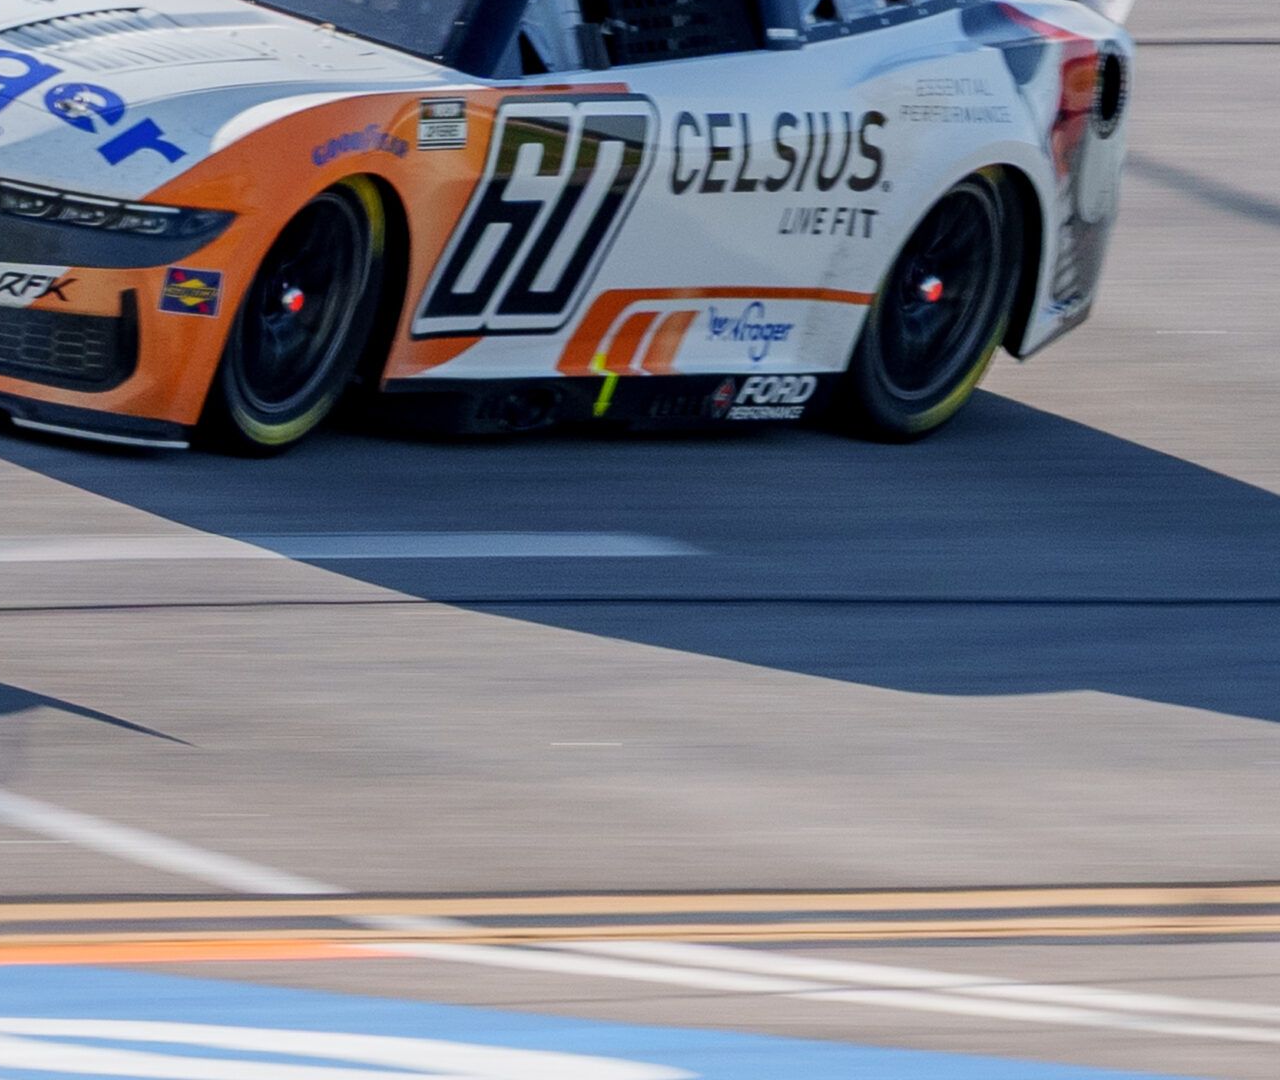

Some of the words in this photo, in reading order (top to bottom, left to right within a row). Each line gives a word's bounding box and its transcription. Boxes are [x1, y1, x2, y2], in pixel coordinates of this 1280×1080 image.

[671, 110, 889, 195] CELSIUS
[412, 100, 652, 336] 60
[778, 207, 828, 236] LIVE
[830, 207, 879, 239] FIT
[735, 375, 817, 404] FORD
